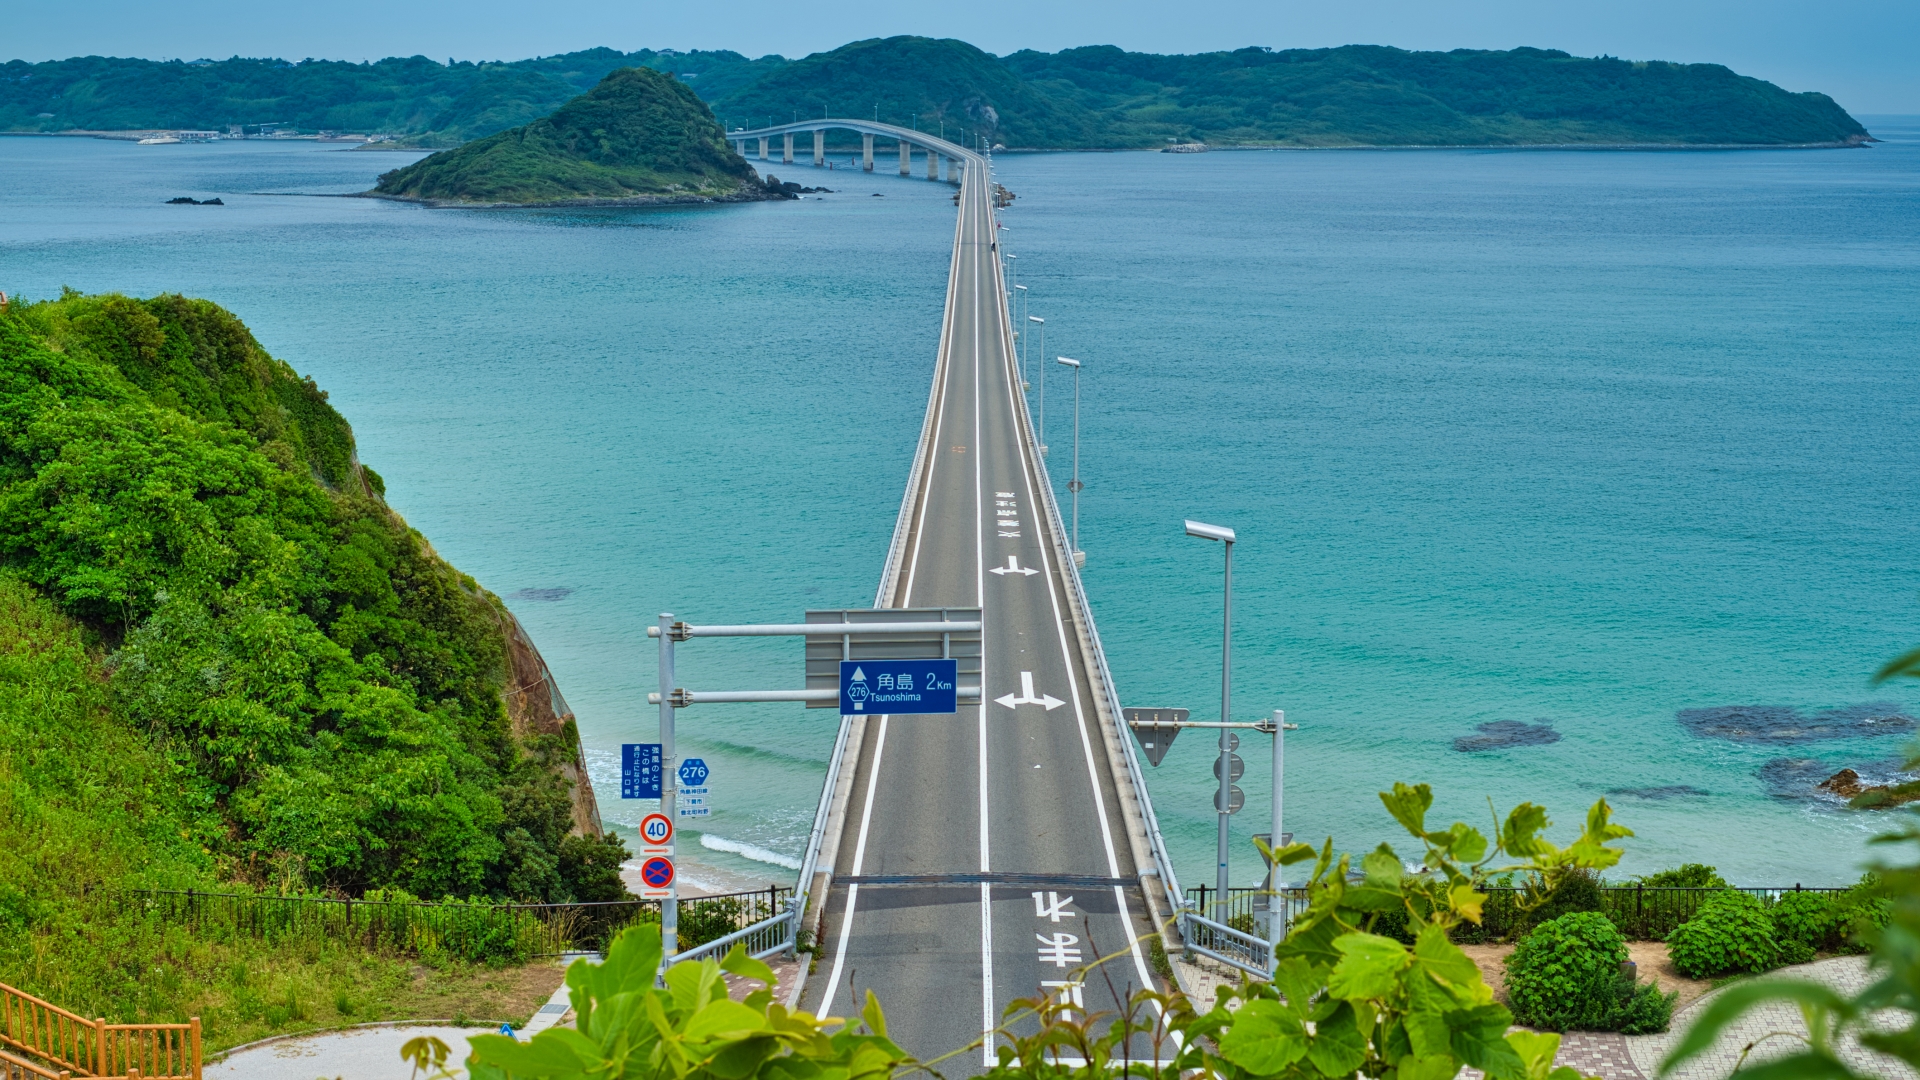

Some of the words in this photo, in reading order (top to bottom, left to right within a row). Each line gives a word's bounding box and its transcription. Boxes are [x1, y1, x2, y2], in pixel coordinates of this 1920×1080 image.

[877, 673, 913, 691] 角島
[926, 672, 952, 690] 2Km
[851, 687, 866, 697] 276
[870, 692, 921, 702] Tsunoshima
[642, 749, 650, 784] この橋は
[651, 746, 660, 791] 強風のとき
[682, 766, 706, 778] 276
[647, 822, 666, 837] 40
